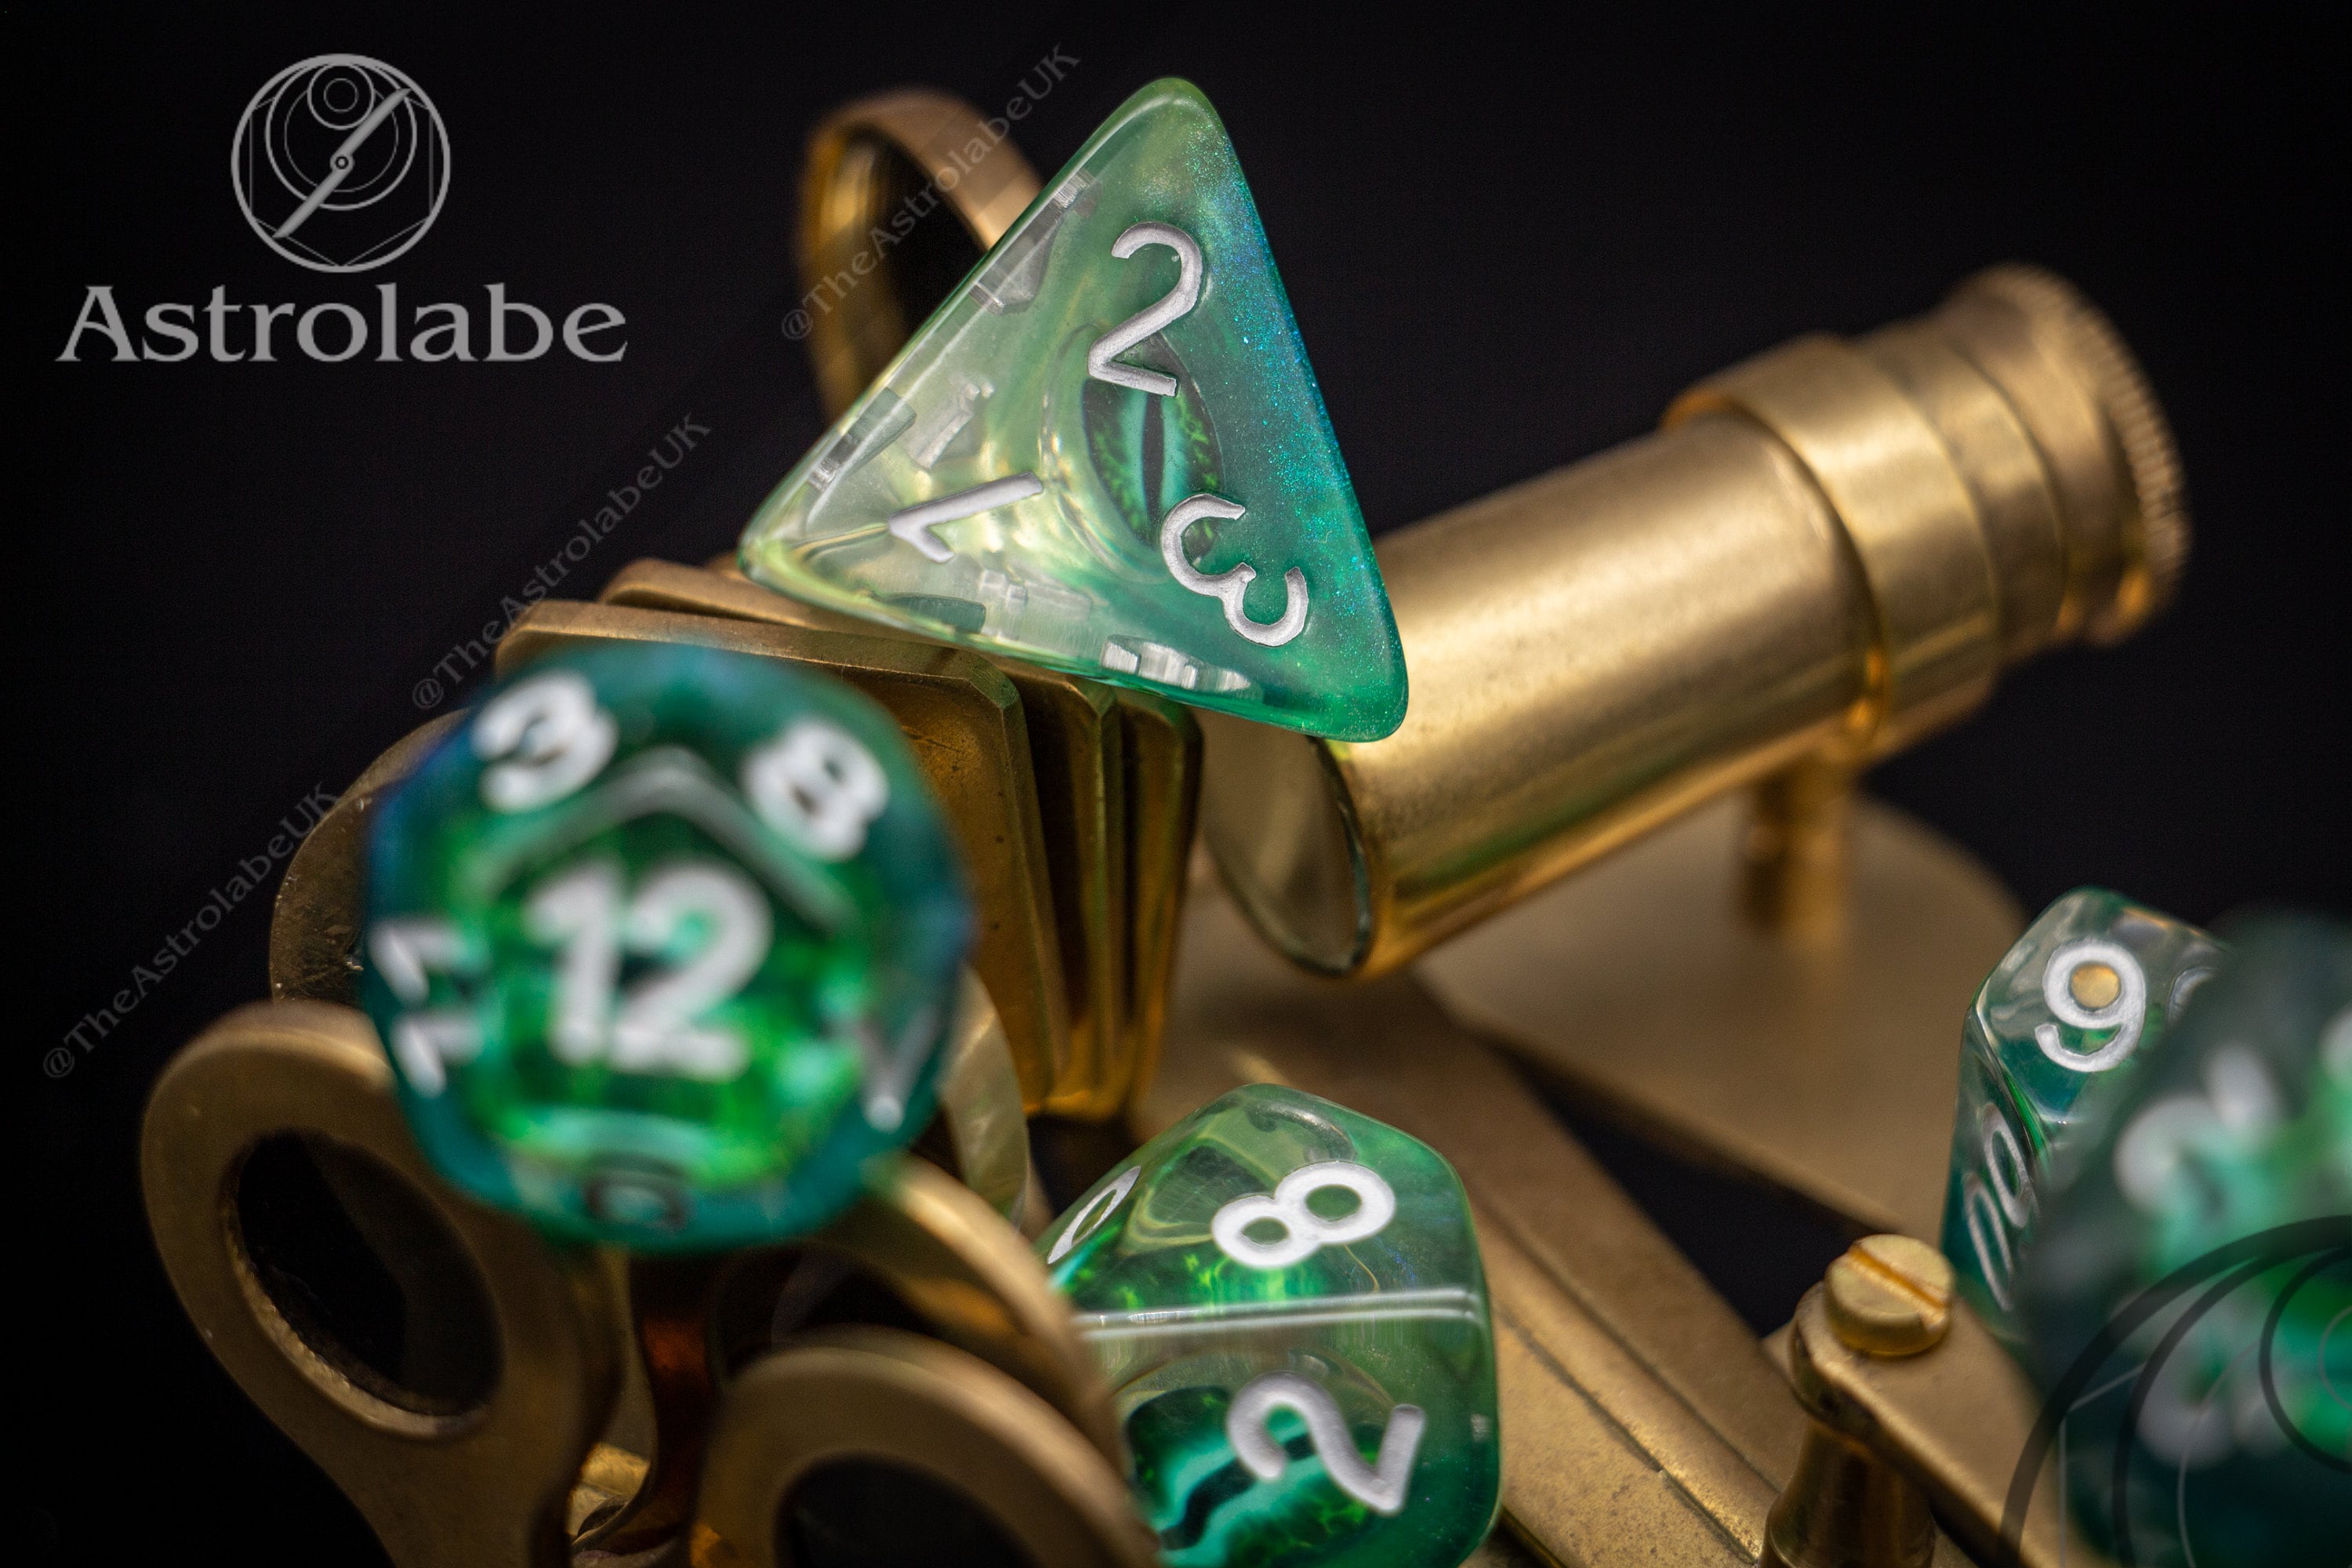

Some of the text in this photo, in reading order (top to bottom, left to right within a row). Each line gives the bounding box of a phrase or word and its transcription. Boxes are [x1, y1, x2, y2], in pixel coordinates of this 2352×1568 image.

[1087, 222, 1204, 397] 2
[1161, 492, 1309, 648] 3
[743, 721, 888, 860] 8
[525, 859, 775, 1082] 12
[2034, 939, 2217, 1075] 9
[1211, 1160, 1396, 1269] 8
[1227, 1371, 1425, 1515] 2
